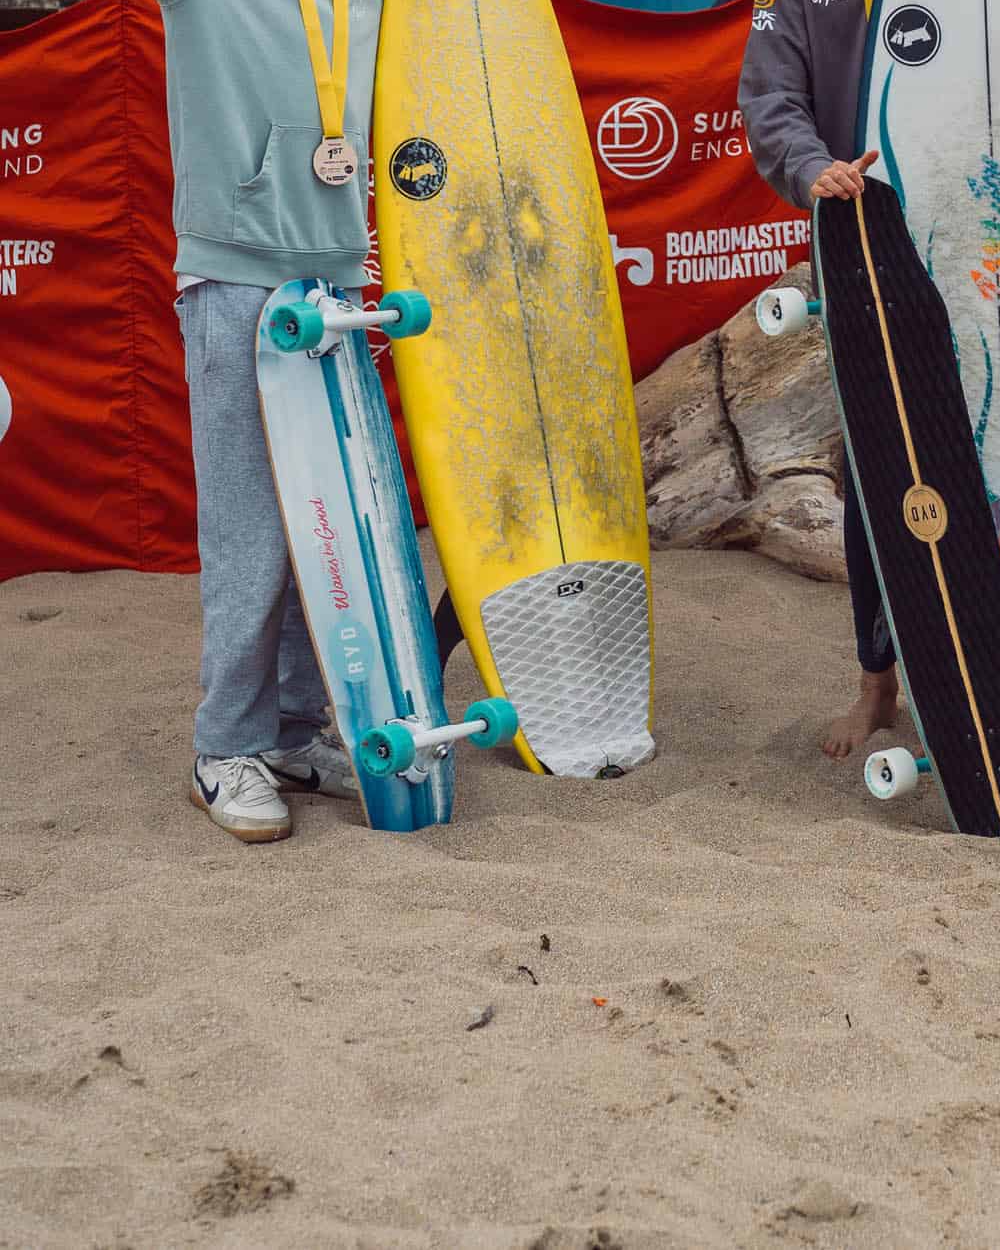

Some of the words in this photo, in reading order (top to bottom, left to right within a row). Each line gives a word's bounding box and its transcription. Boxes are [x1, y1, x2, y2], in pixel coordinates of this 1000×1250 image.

[665, 249, 788, 286] FOUNDATION
[911, 505, 938, 523] RYD
[341, 627, 366, 675] RYD
